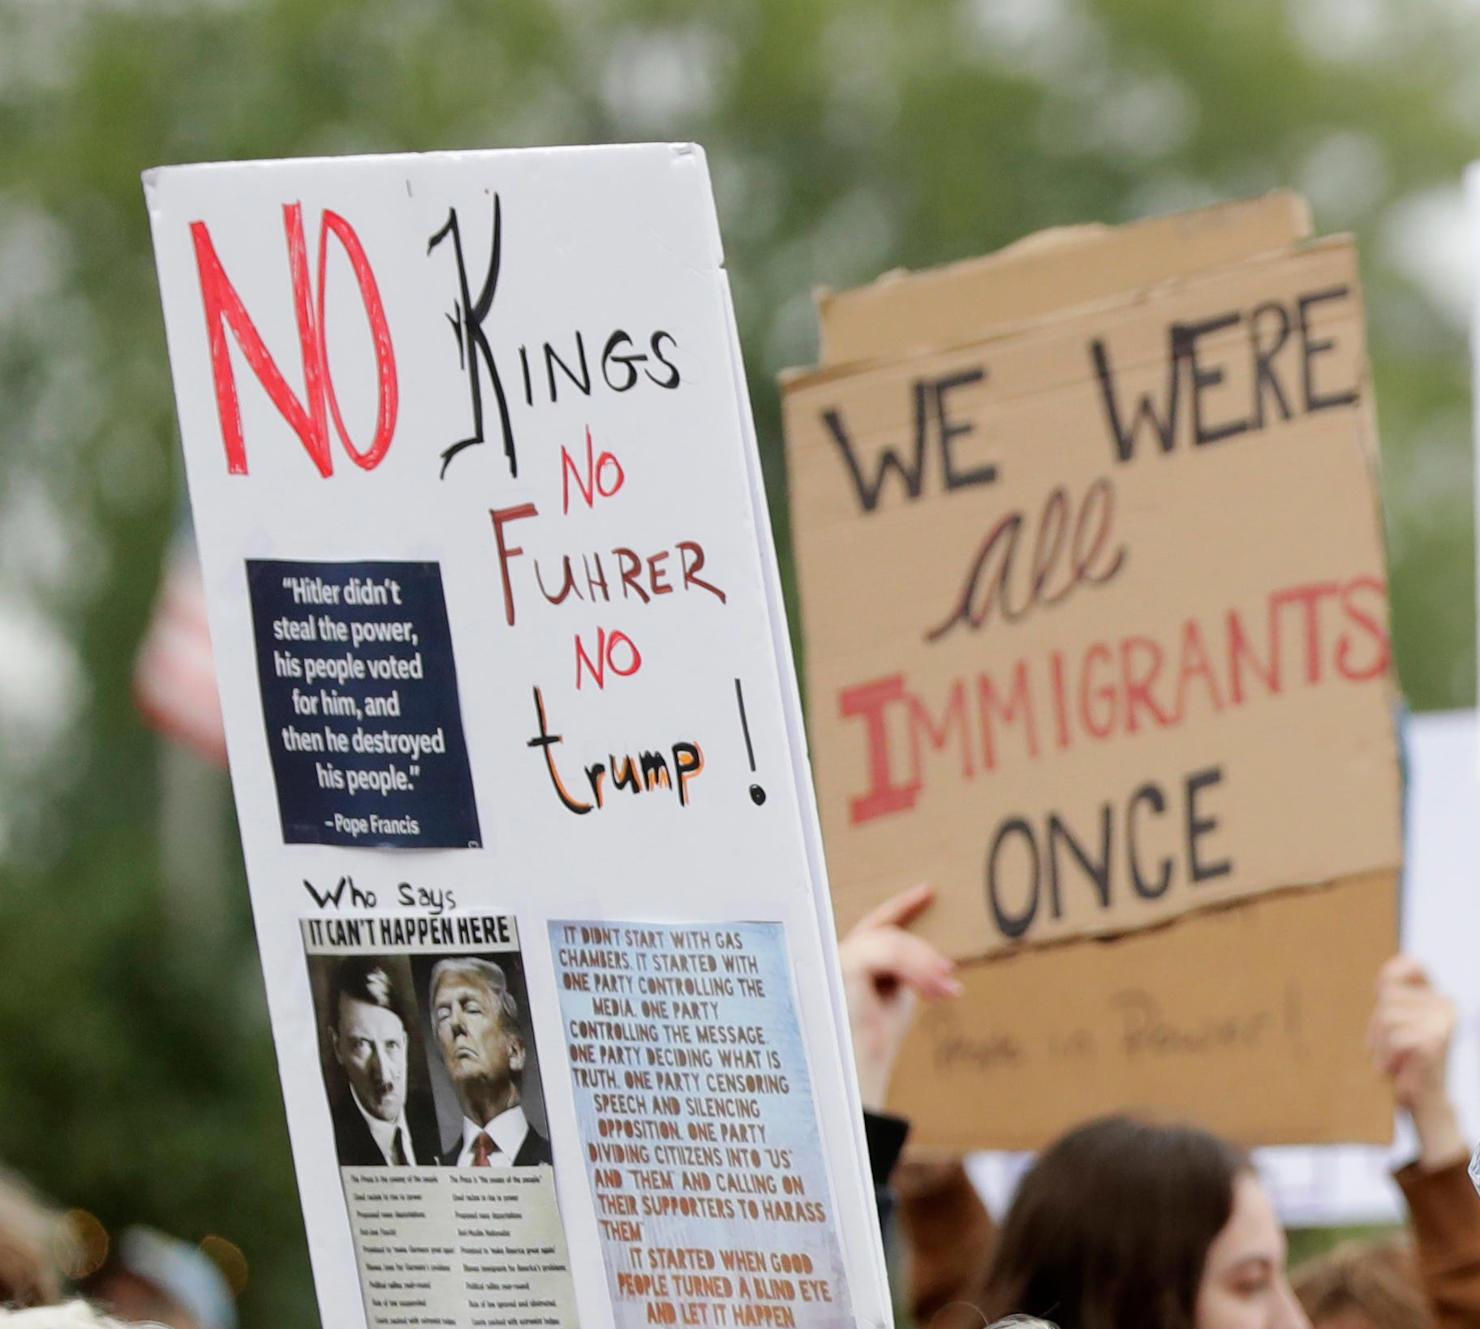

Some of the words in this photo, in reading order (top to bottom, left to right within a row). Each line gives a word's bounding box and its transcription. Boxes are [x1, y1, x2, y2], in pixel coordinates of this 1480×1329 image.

[189, 199, 399, 479] NO
[819, 365, 1000, 515] WE
[1090, 284, 1362, 465] WERE
[561, 423, 624, 515] NO
[922, 476, 1130, 646] all
[273, 615, 316, 641] steal
[318, 615, 348, 642] the
[351, 620, 418, 648] power,
[274, 650, 301, 678] his
[304, 654, 365, 684] people
[367, 652, 423, 679] voted
[574, 625, 641, 690] NO
[292, 688, 318, 714] for
[321, 689, 363, 720] him,
[365, 690, 400, 717] and
[836, 574, 1393, 826] IMMIGRANTS
[282, 725, 324, 752] then
[325, 726, 349, 752] he
[352, 727, 445, 760] destroyed
[316, 762, 344, 789] his
[371, 814, 420, 835] Francis
[985, 763, 1234, 940] ONCE
[303, 875, 376, 909] Who
[398, 882, 457, 915] Says
[308, 919, 322, 946] IT
[327, 918, 376, 946] CAN'T
[381, 917, 454, 945] HAPPEN
[457, 916, 510, 944] HERE
[564, 926, 576, 945] IT
[626, 930, 664, 949] START
[670, 931, 710, 949] WITH
[716, 932, 742, 950] GAS
[636, 952, 647, 971] IT
[654, 953, 717, 973] STARTED
[722, 955, 758, 974] WITH
[563, 972, 590, 992] ONE
[595, 974, 633, 994] PARTY
[639, 977, 734, 996] CONTROLLING
[738, 979, 765, 998] THE
[641, 1000, 668, 1019] ONE
[673, 1001, 718, 1020] PARTY
[570, 1020, 658, 1042] CONTROLLING
[663, 1025, 691, 1043] THE
[569, 1044, 596, 1063] ONE
[600, 1046, 641, 1065] PARTY
[648, 1048, 712, 1067] DECIDING
[718, 1050, 761, 1068] WHAT
[767, 1051, 781, 1070] IS
[624, 1070, 651, 1090] ONE
[656, 1072, 700, 1092] PARTY
[706, 1074, 789, 1094] CENSORING
[594, 1094, 647, 1114] SPEECH
[652, 1096, 680, 1116] AND
[686, 1098, 760, 1118] SILENCING
[688, 1121, 717, 1142] ONE
[721, 1123, 766, 1144] PARTY
[588, 1142, 650, 1163] DIVIDING
[727, 1149, 760, 1168] INTO
[594, 1169, 622, 1188] AND
[682, 1173, 711, 1192] AND
[716, 1174, 776, 1194] CALLING
[783, 1176, 804, 1196] ON
[597, 1194, 643, 1216] THEIR
[644, 1195, 735, 1218] SUPPORTERS
[740, 1201, 758, 1220] TO
[763, 1202, 826, 1223] HARASS
[630, 1247, 642, 1268] IT
[649, 1248, 715, 1270] STARTED
[719, 1251, 767, 1272] WHEN
[770, 1254, 813, 1275] GOOD
[617, 1272, 668, 1296] PEOPLE
[672, 1275, 733, 1298] TURNED
[740, 1279, 750, 1298] A
[754, 1279, 795, 1300] BLIND
[799, 1281, 832, 1302] EYE
[647, 1301, 676, 1324] AND
[681, 1303, 710, 1325] LET
[714, 1304, 727, 1326] IT
[733, 1306, 795, 1328] HAPPEN
